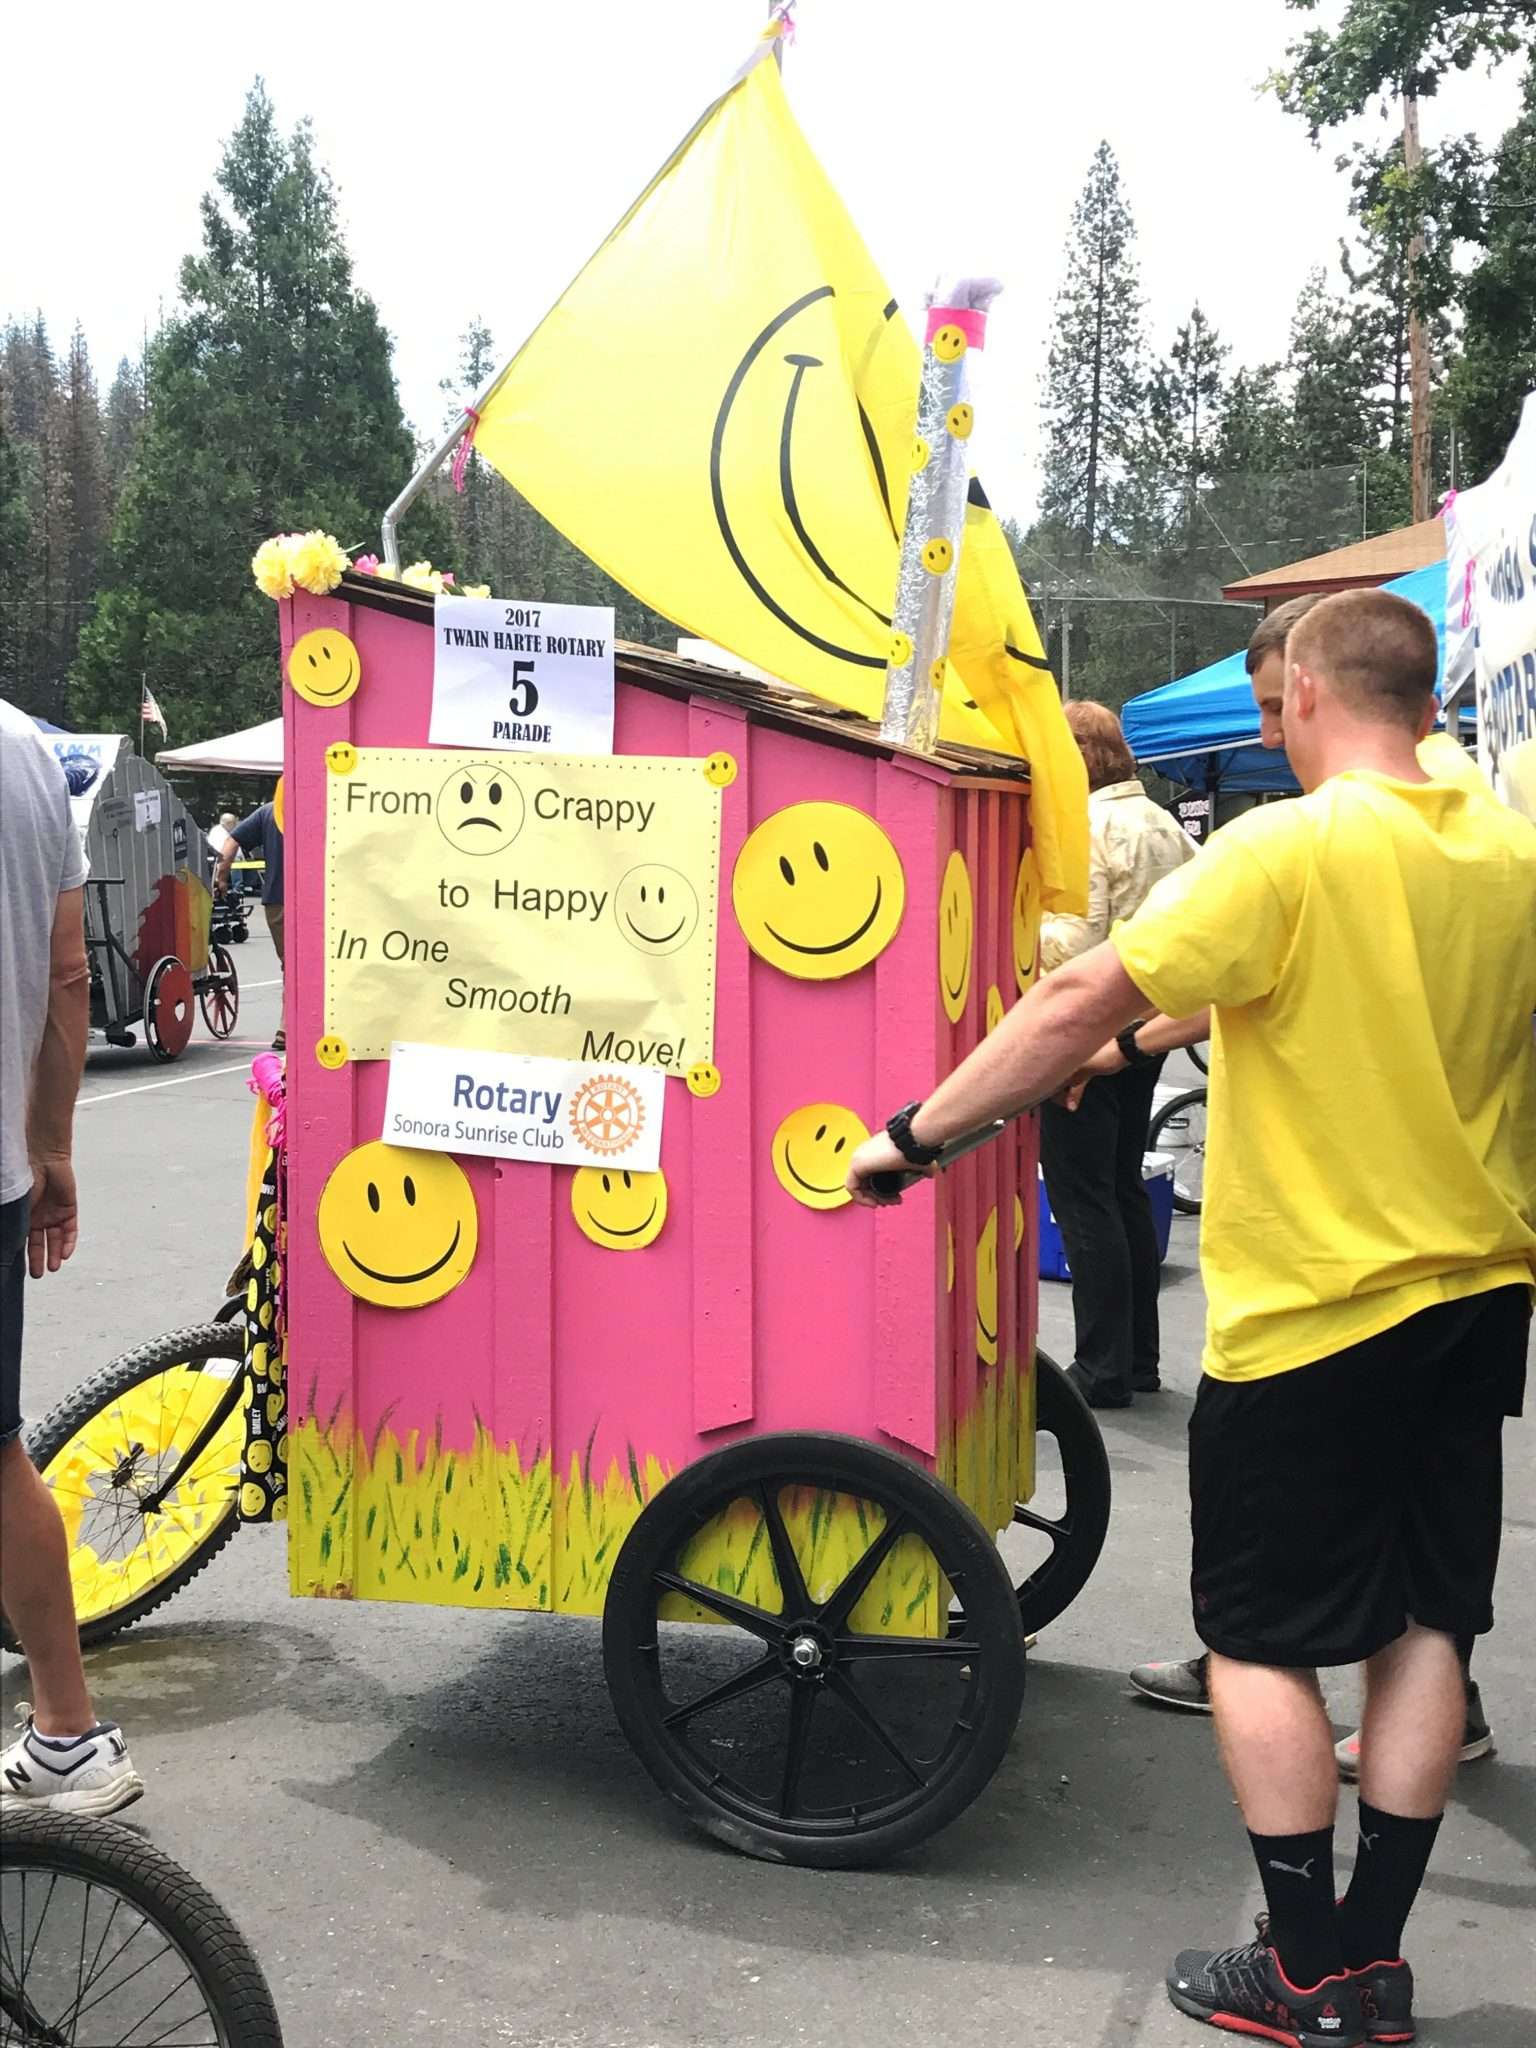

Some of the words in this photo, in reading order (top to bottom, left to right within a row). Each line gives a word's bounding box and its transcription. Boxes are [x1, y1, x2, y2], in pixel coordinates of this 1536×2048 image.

[505, 608, 541, 628] 2017
[444, 628, 489, 648] TWAIN
[494, 632, 542, 653] HARTE
[547, 636, 605, 657] ROTARY
[509, 660, 539, 717] 5
[492, 721, 551, 743] PARADE
[346, 783, 432, 815] From
[534, 788, 655, 832] Crappy
[438, 878, 469, 908] to
[494, 880, 608, 921] Happy
[337, 930, 367, 960] In
[382, 930, 449, 962] One
[446, 978, 571, 1015] Smooth
[581, 1030, 686, 1069] Move!
[453, 1074, 562, 1122] Rotary
[393, 1113, 450, 1138] Sonora
[455, 1120, 518, 1146] Sunrise
[522, 1126, 564, 1149] Club
[251, 1408, 262, 1436] SMILEY
